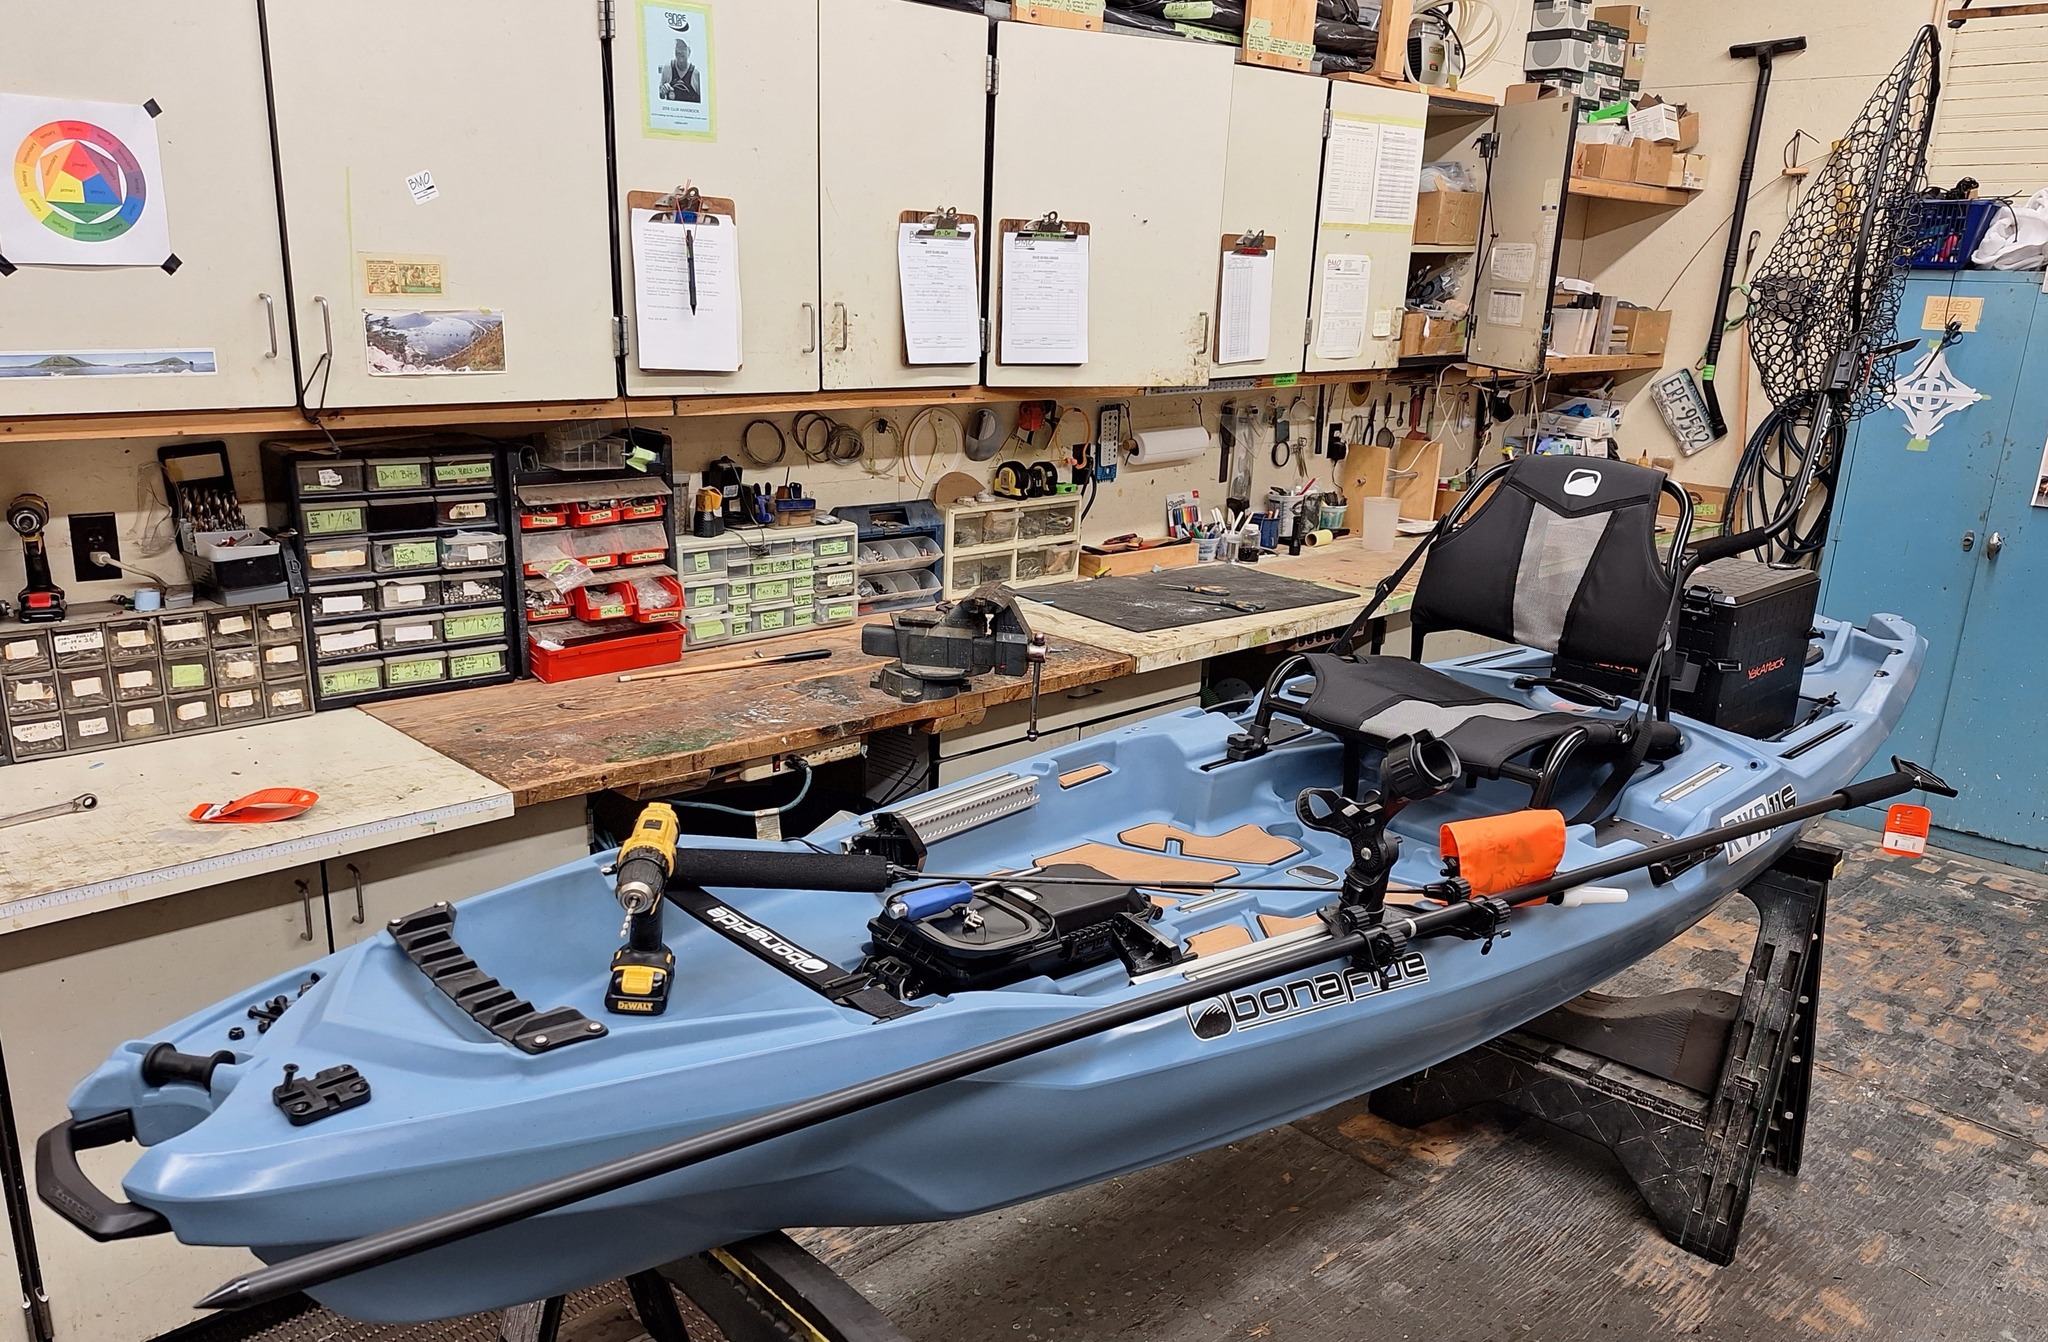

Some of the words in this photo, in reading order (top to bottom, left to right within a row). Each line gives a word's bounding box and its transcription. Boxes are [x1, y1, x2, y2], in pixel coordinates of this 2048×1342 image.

[408, 171, 430, 191] BMO
[380, 469, 397, 481] Drill
[400, 469, 419, 478] Bits
